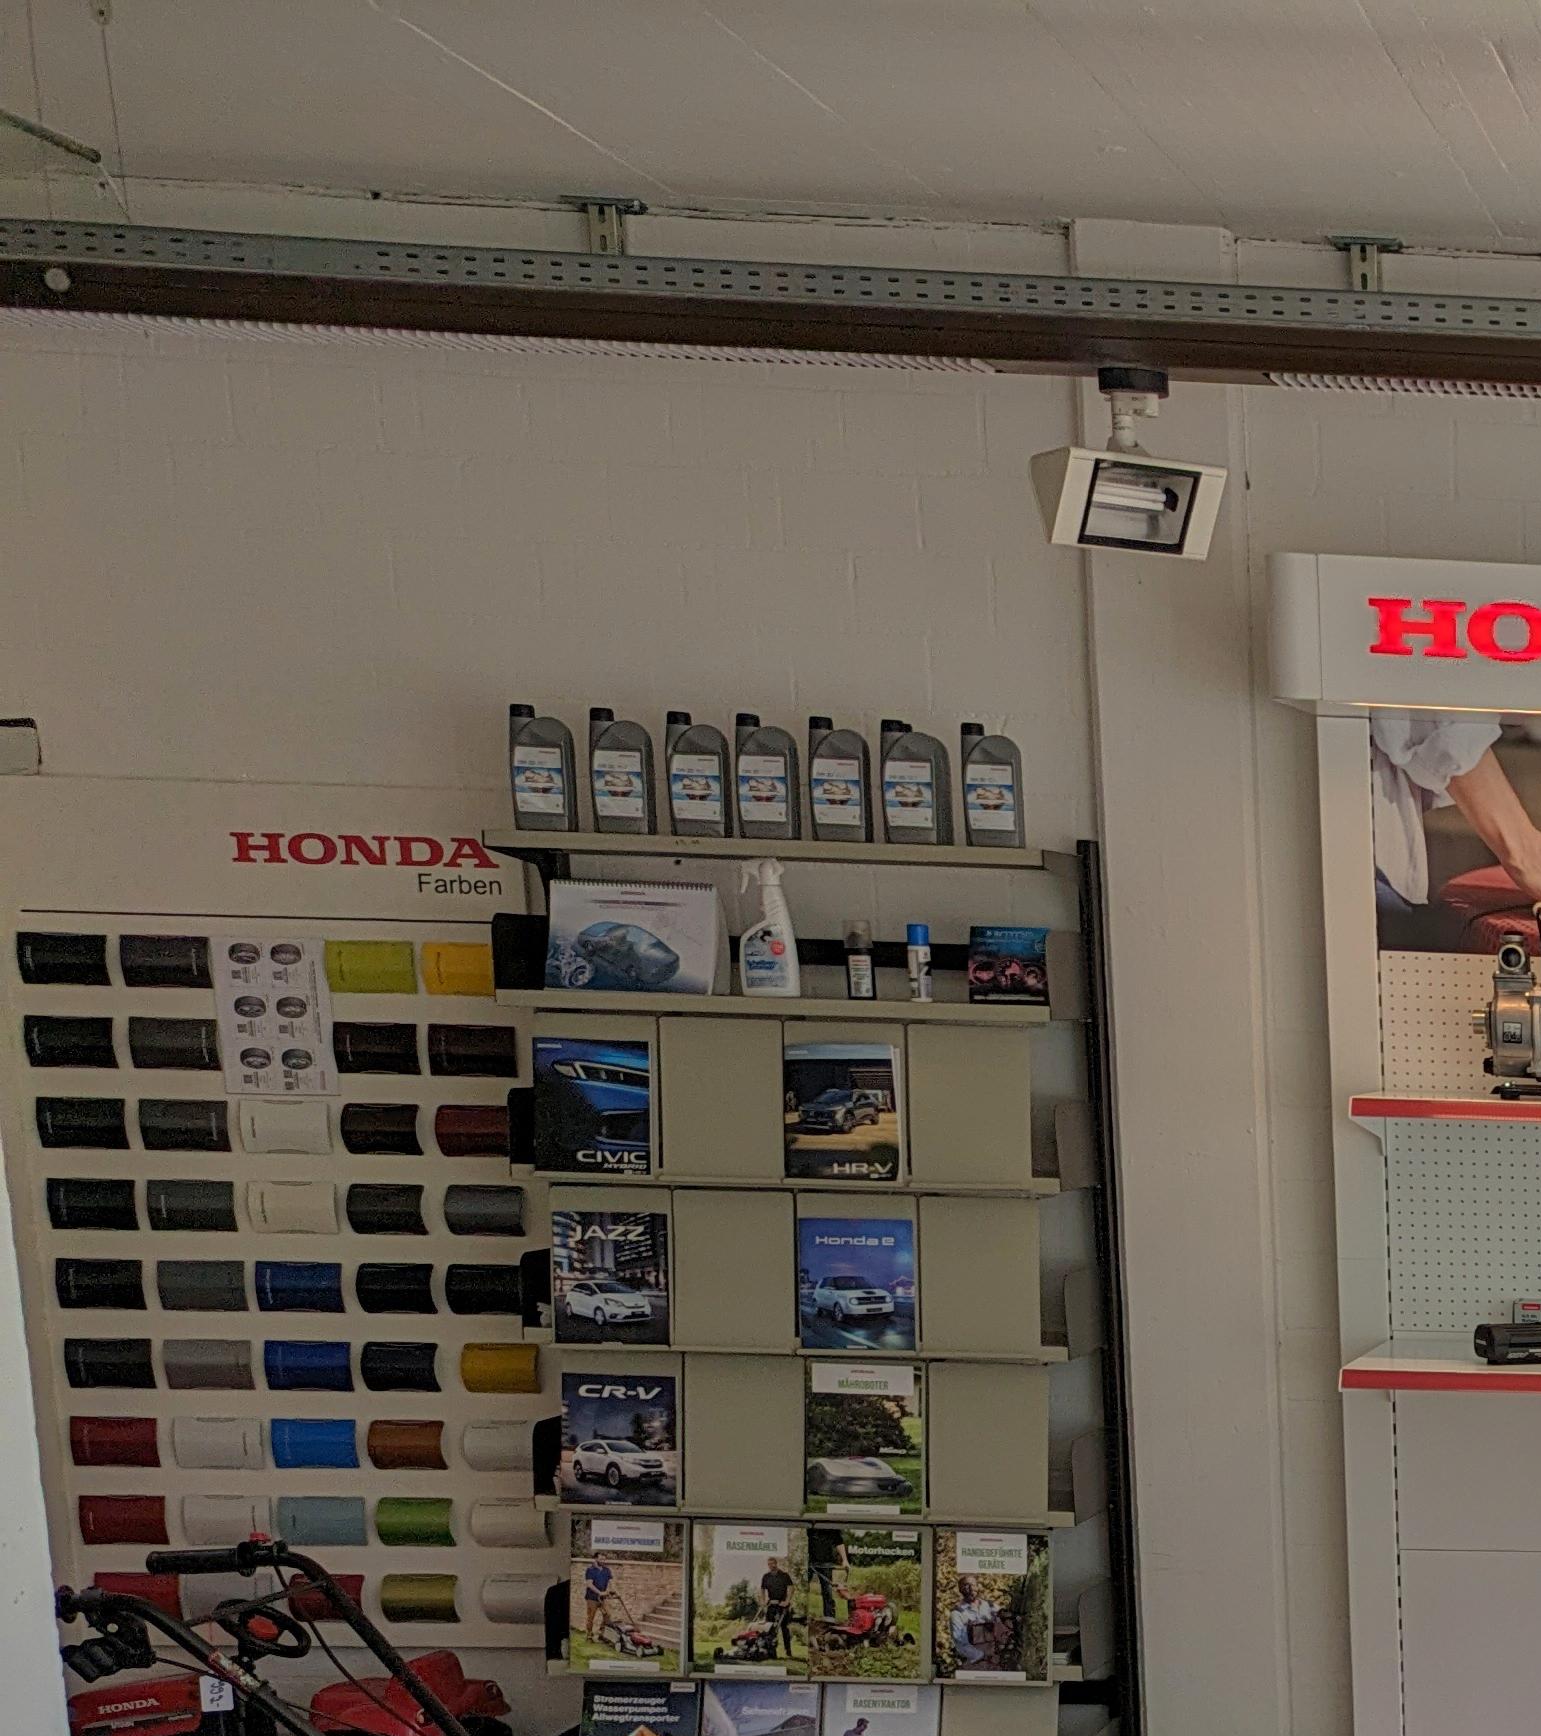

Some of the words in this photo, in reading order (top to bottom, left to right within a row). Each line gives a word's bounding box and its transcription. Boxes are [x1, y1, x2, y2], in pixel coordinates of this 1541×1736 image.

[229, 832, 501, 868] HONDA
[417, 873, 502, 896] Farben
[576, 1150, 648, 1164] CIVIC
[832, 1162, 893, 1174] HR-V
[573, 1225, 650, 1241] JAZZ
[815, 1235, 879, 1246] Honda
[881, 1236, 895, 1246] e
[837, 1379, 889, 1391] MÄHROBOTER
[578, 1384, 662, 1400] CR-V
[725, 1540, 778, 1551] RASENMÄHER
[848, 1545, 915, 1557] Motorhacken
[593, 1694, 667, 1705] Stromerzeuger
[852, 1698, 911, 1710] RASENTRAKTOR
[98, 1698, 160, 1715] HONDA
[592, 1704, 668, 1714] Wasserpumpen
[591, 1712, 681, 1723] Allwegtransporter
